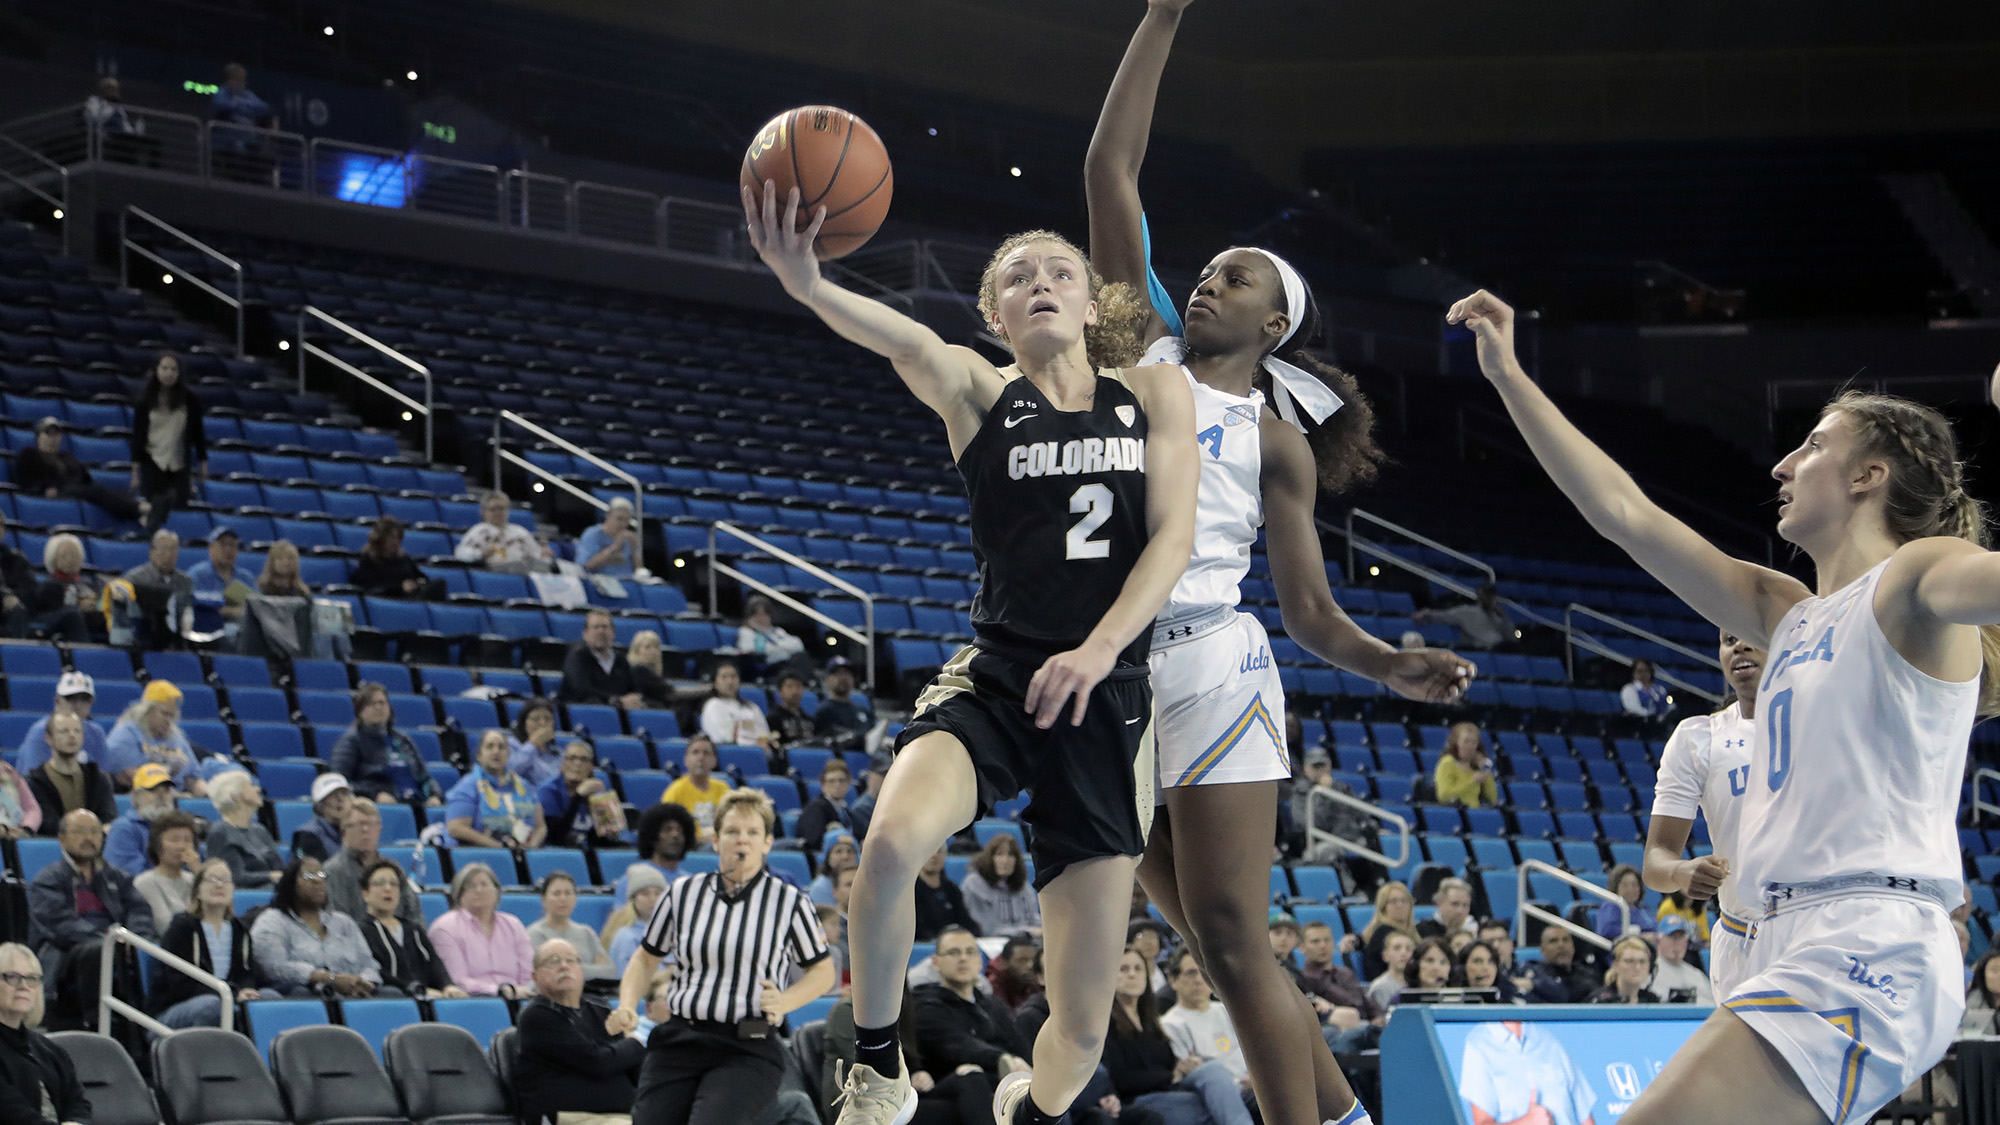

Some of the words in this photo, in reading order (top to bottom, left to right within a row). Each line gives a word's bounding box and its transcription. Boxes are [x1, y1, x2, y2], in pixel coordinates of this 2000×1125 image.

[1012, 400, 1024, 409] JS
[1026, 401, 1037, 409] 15
[1066, 483, 1115, 560] 2
[1768, 687, 1794, 793] 0
